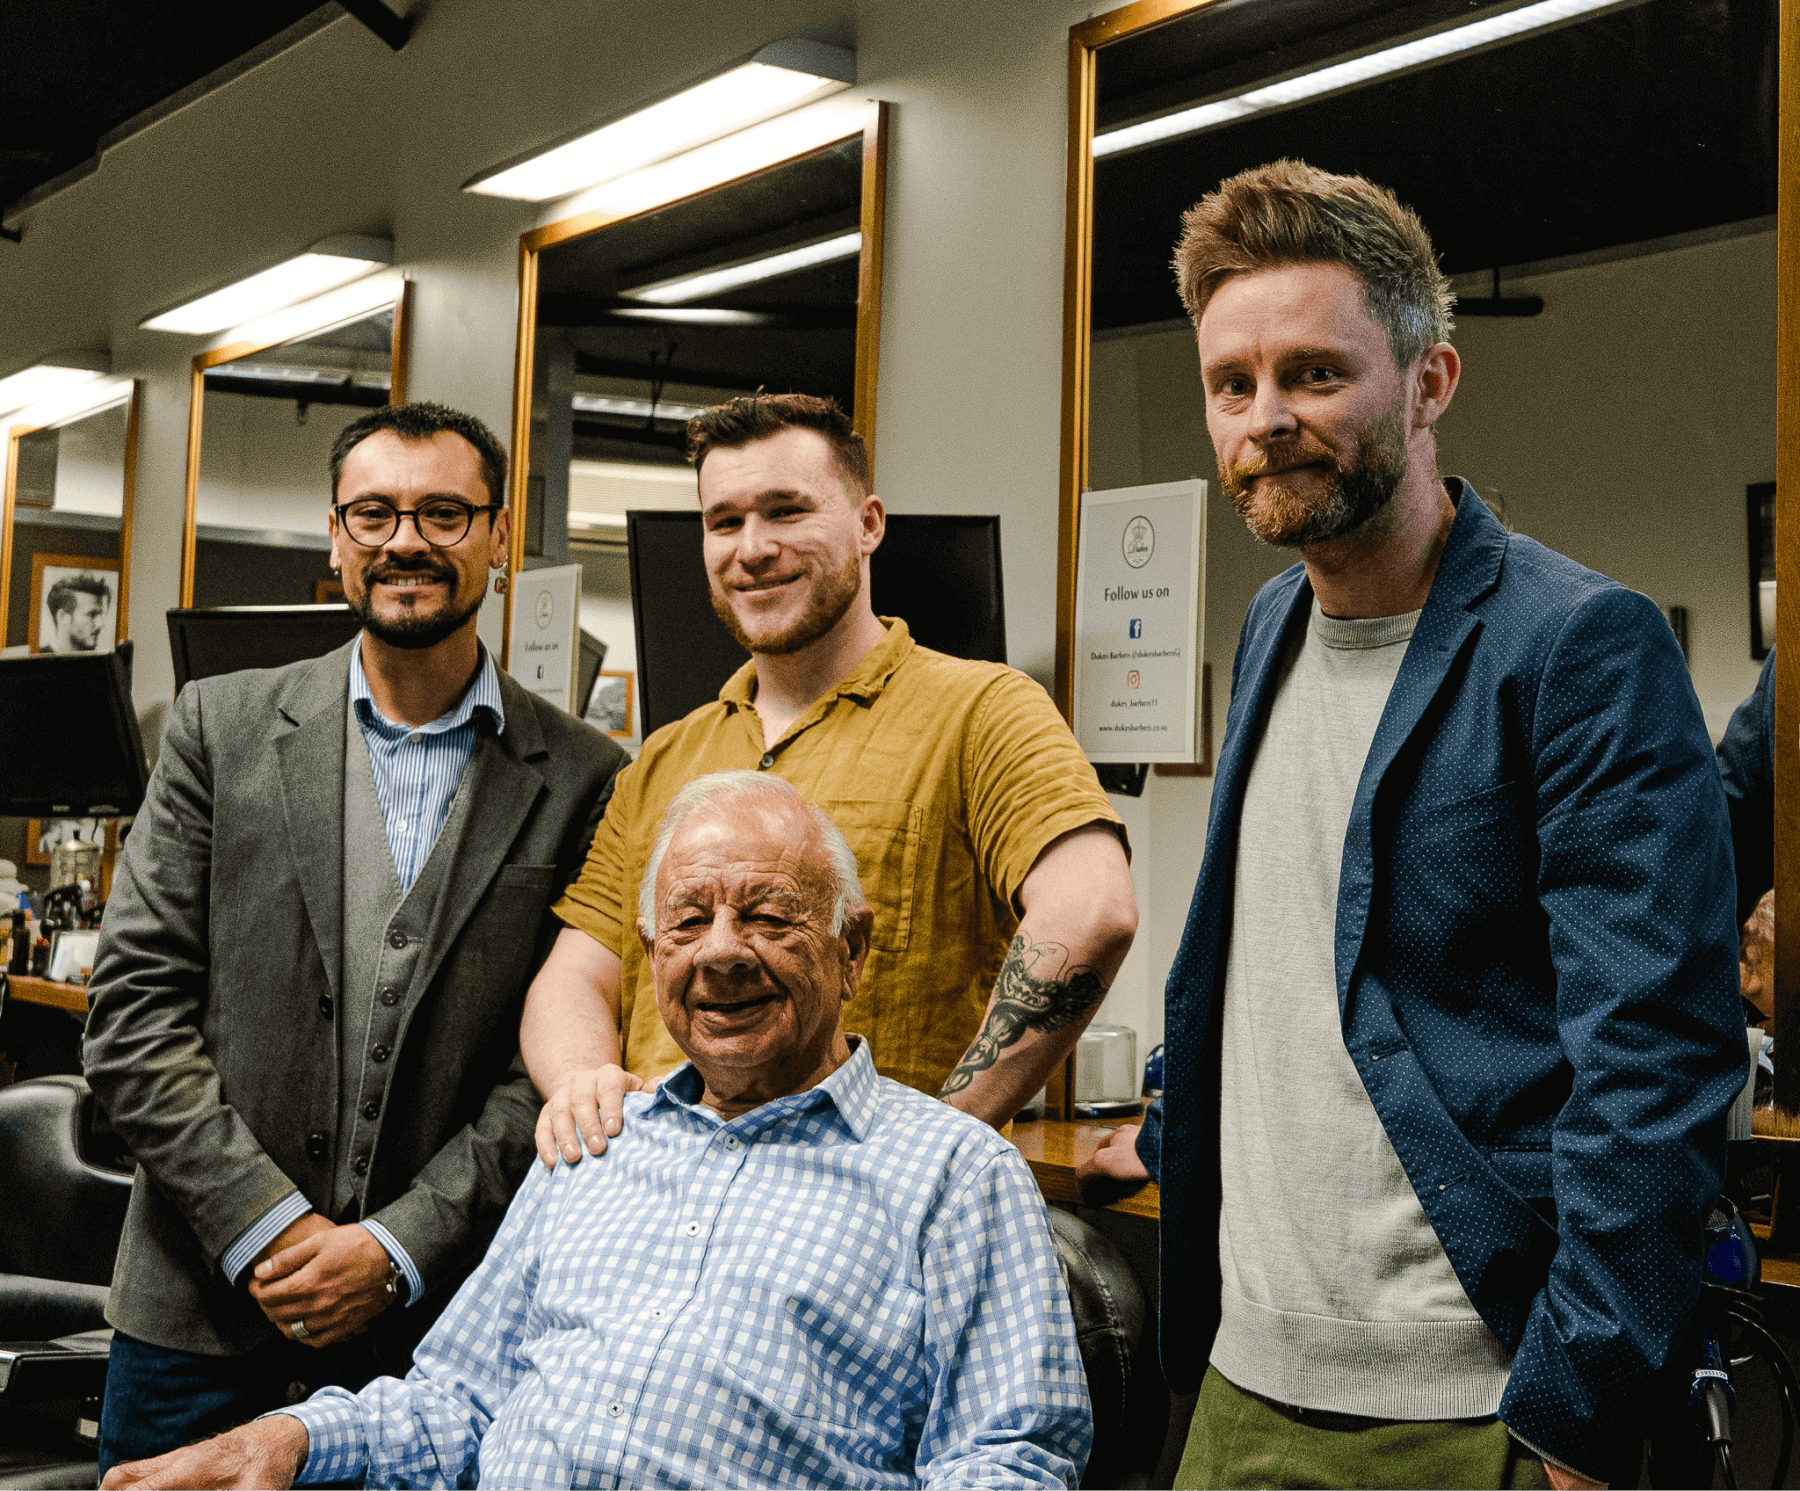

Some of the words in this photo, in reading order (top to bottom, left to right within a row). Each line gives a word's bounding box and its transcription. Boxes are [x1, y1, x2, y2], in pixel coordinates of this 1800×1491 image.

[1104, 586, 1138, 601] Follow
[1142, 588, 1153, 599] us
[1156, 587, 1169, 598] on
